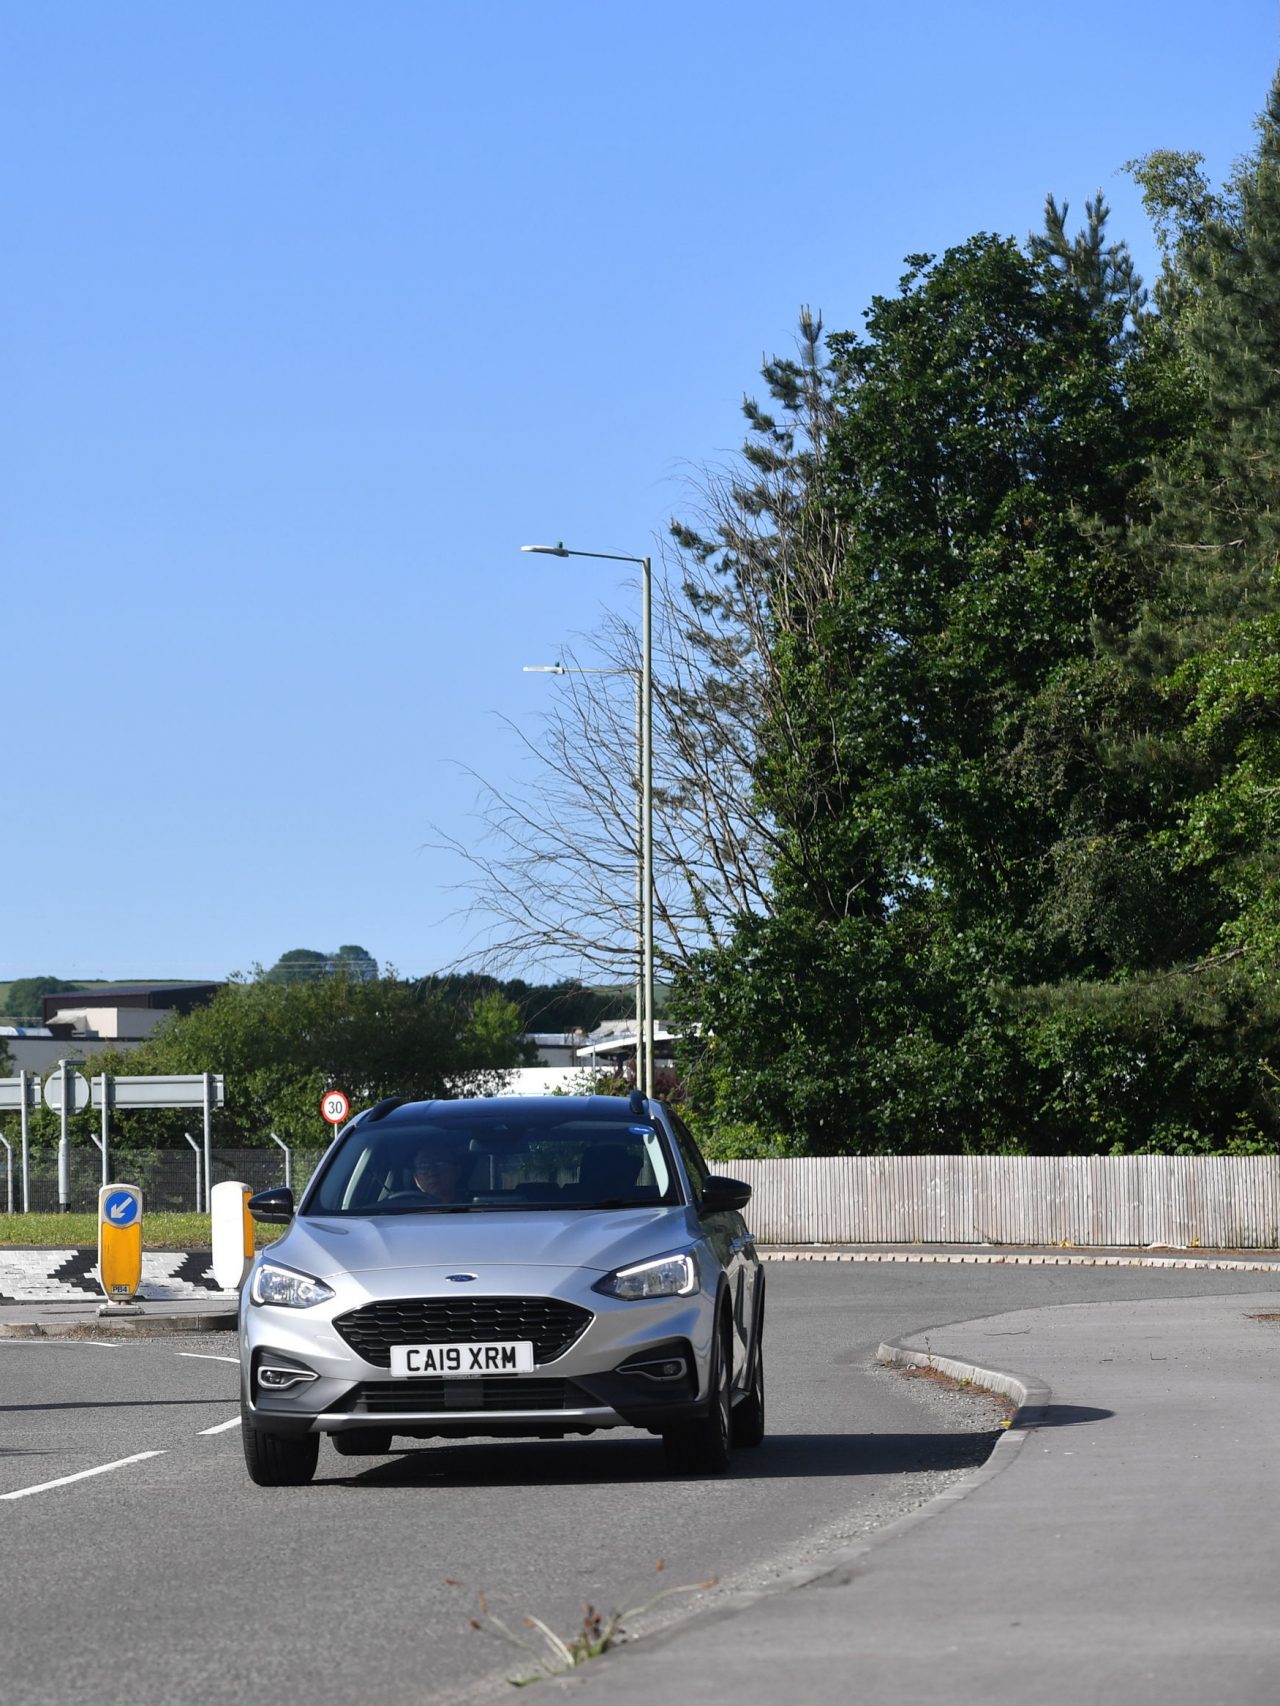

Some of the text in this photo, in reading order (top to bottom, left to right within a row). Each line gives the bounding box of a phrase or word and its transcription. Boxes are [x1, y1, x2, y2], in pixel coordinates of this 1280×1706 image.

[328, 1101, 343, 1114] 30
[406, 1346, 517, 1372] CA19 XRM
